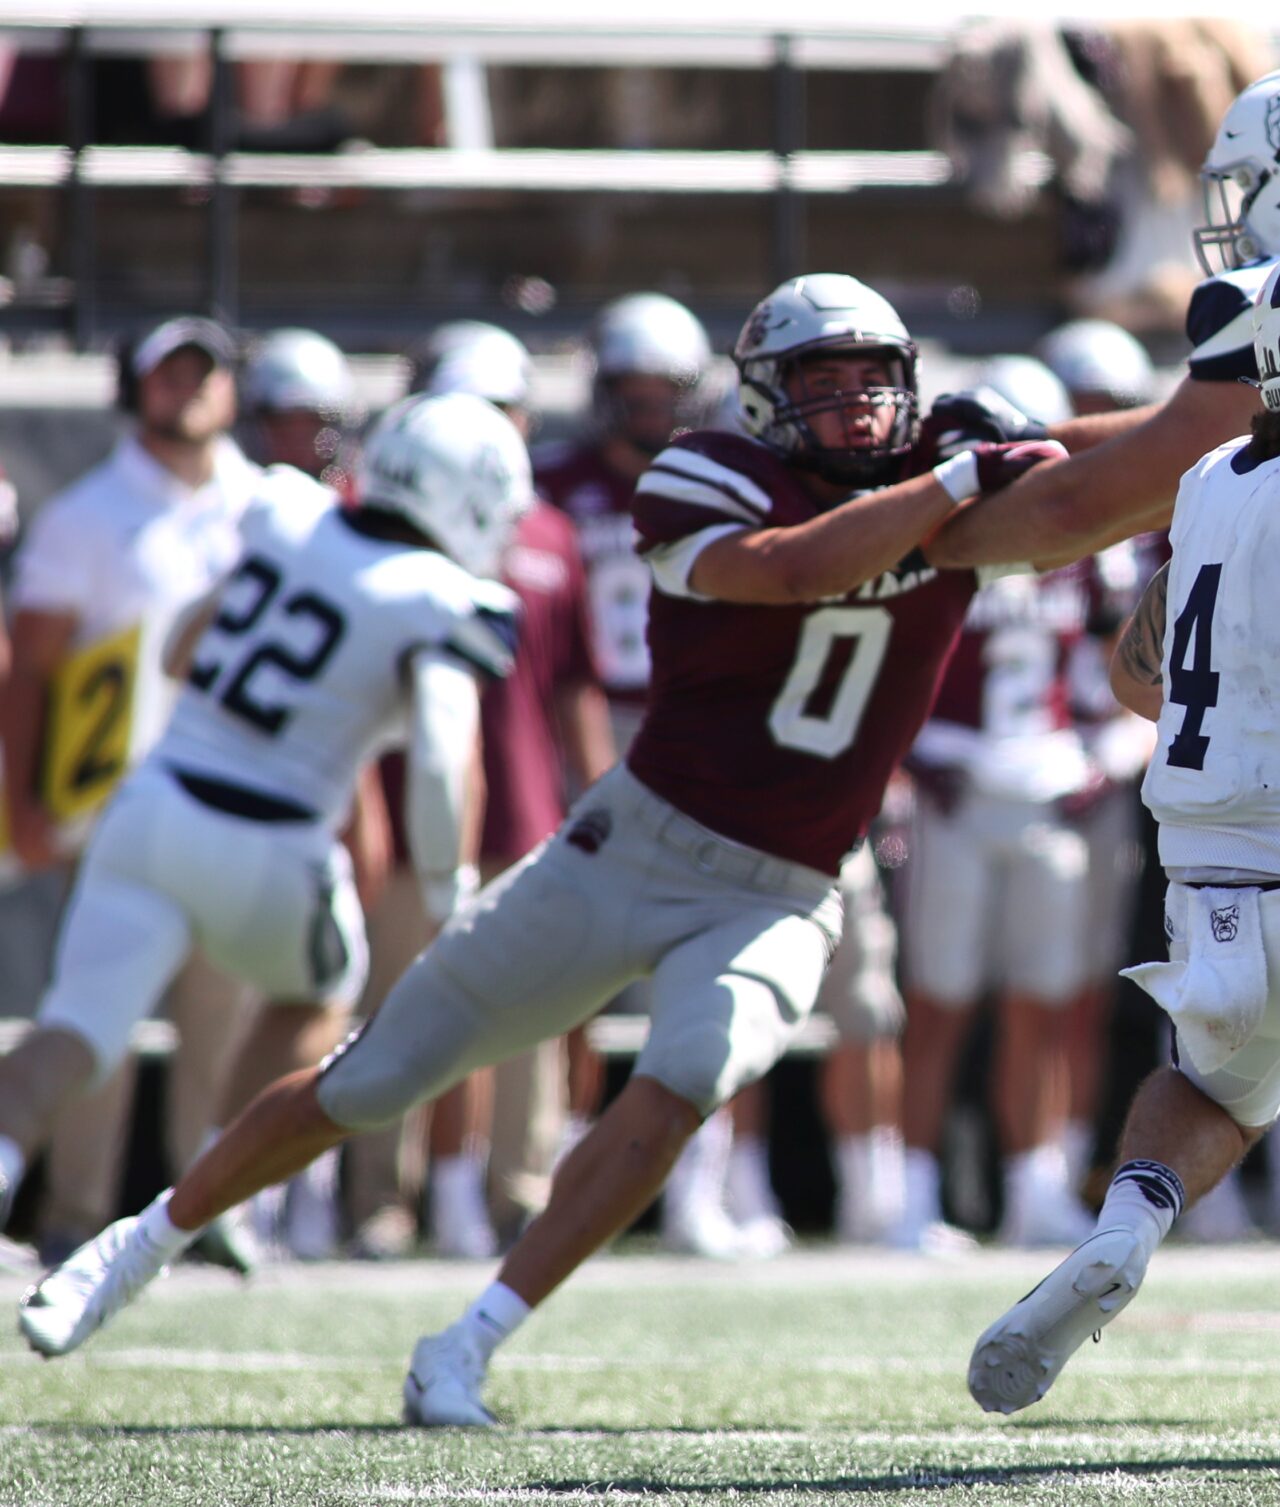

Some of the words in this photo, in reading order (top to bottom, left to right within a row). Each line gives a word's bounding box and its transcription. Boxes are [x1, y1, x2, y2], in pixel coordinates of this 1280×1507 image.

[70, 660, 128, 795] 2
[188, 557, 347, 737] 22
[768, 607, 892, 758] 0
[1166, 563, 1223, 771] 4
